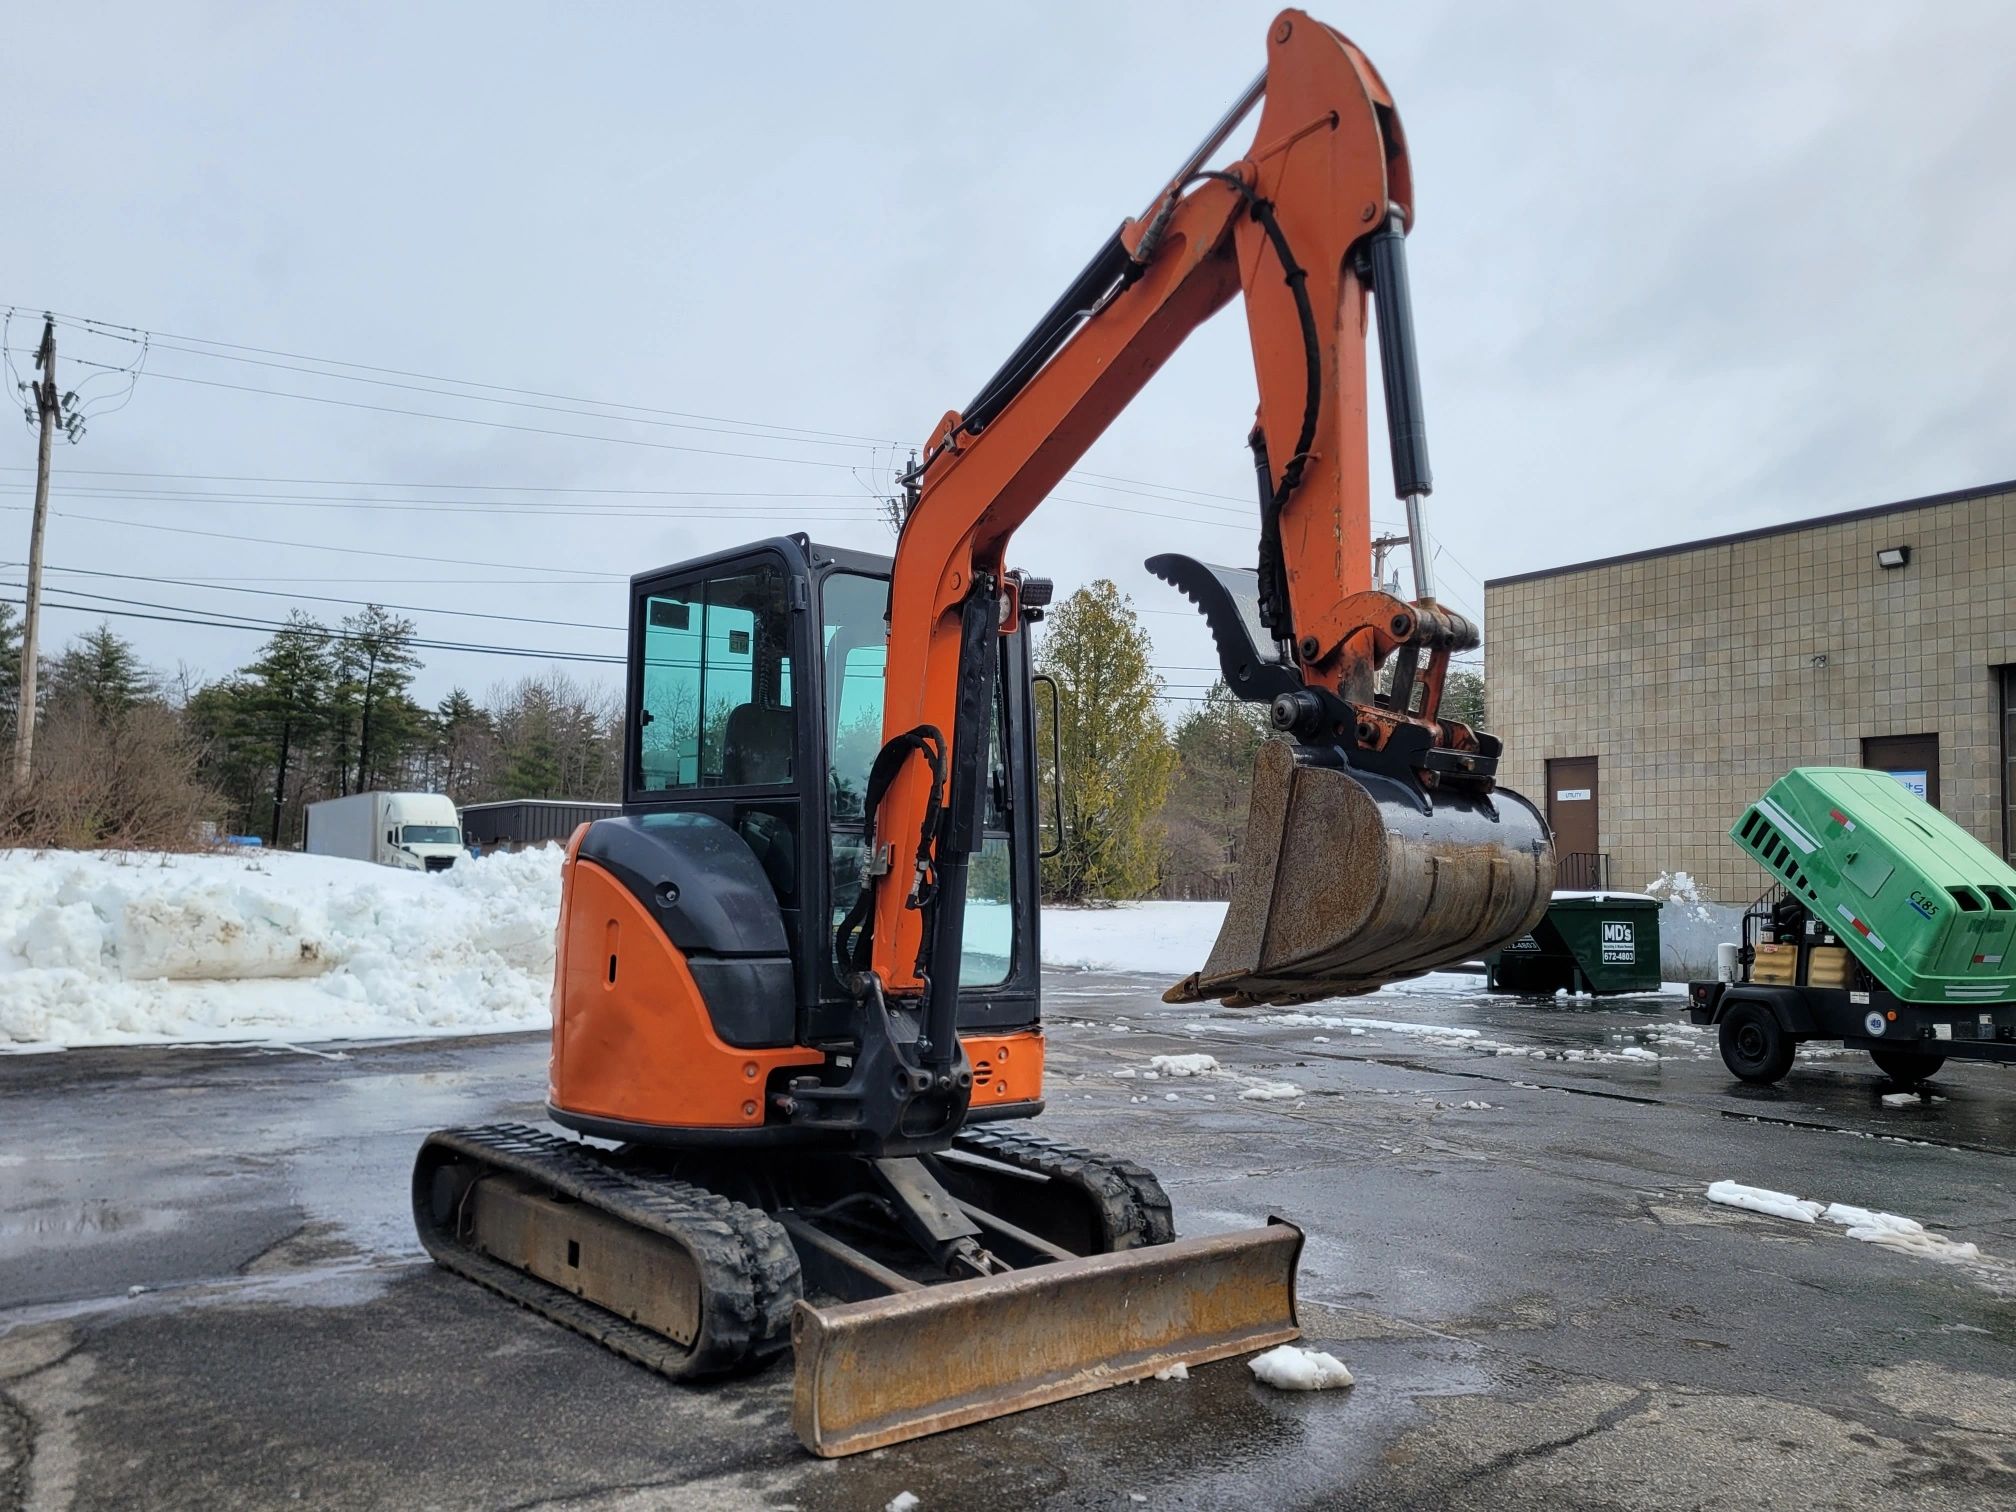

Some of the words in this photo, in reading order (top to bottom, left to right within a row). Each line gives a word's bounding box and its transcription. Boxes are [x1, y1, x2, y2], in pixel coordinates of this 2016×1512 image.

[1910, 891, 1940, 915] C185
[1604, 924, 1632, 941] MD's
[1604, 952, 1634, 961] 672-4803
